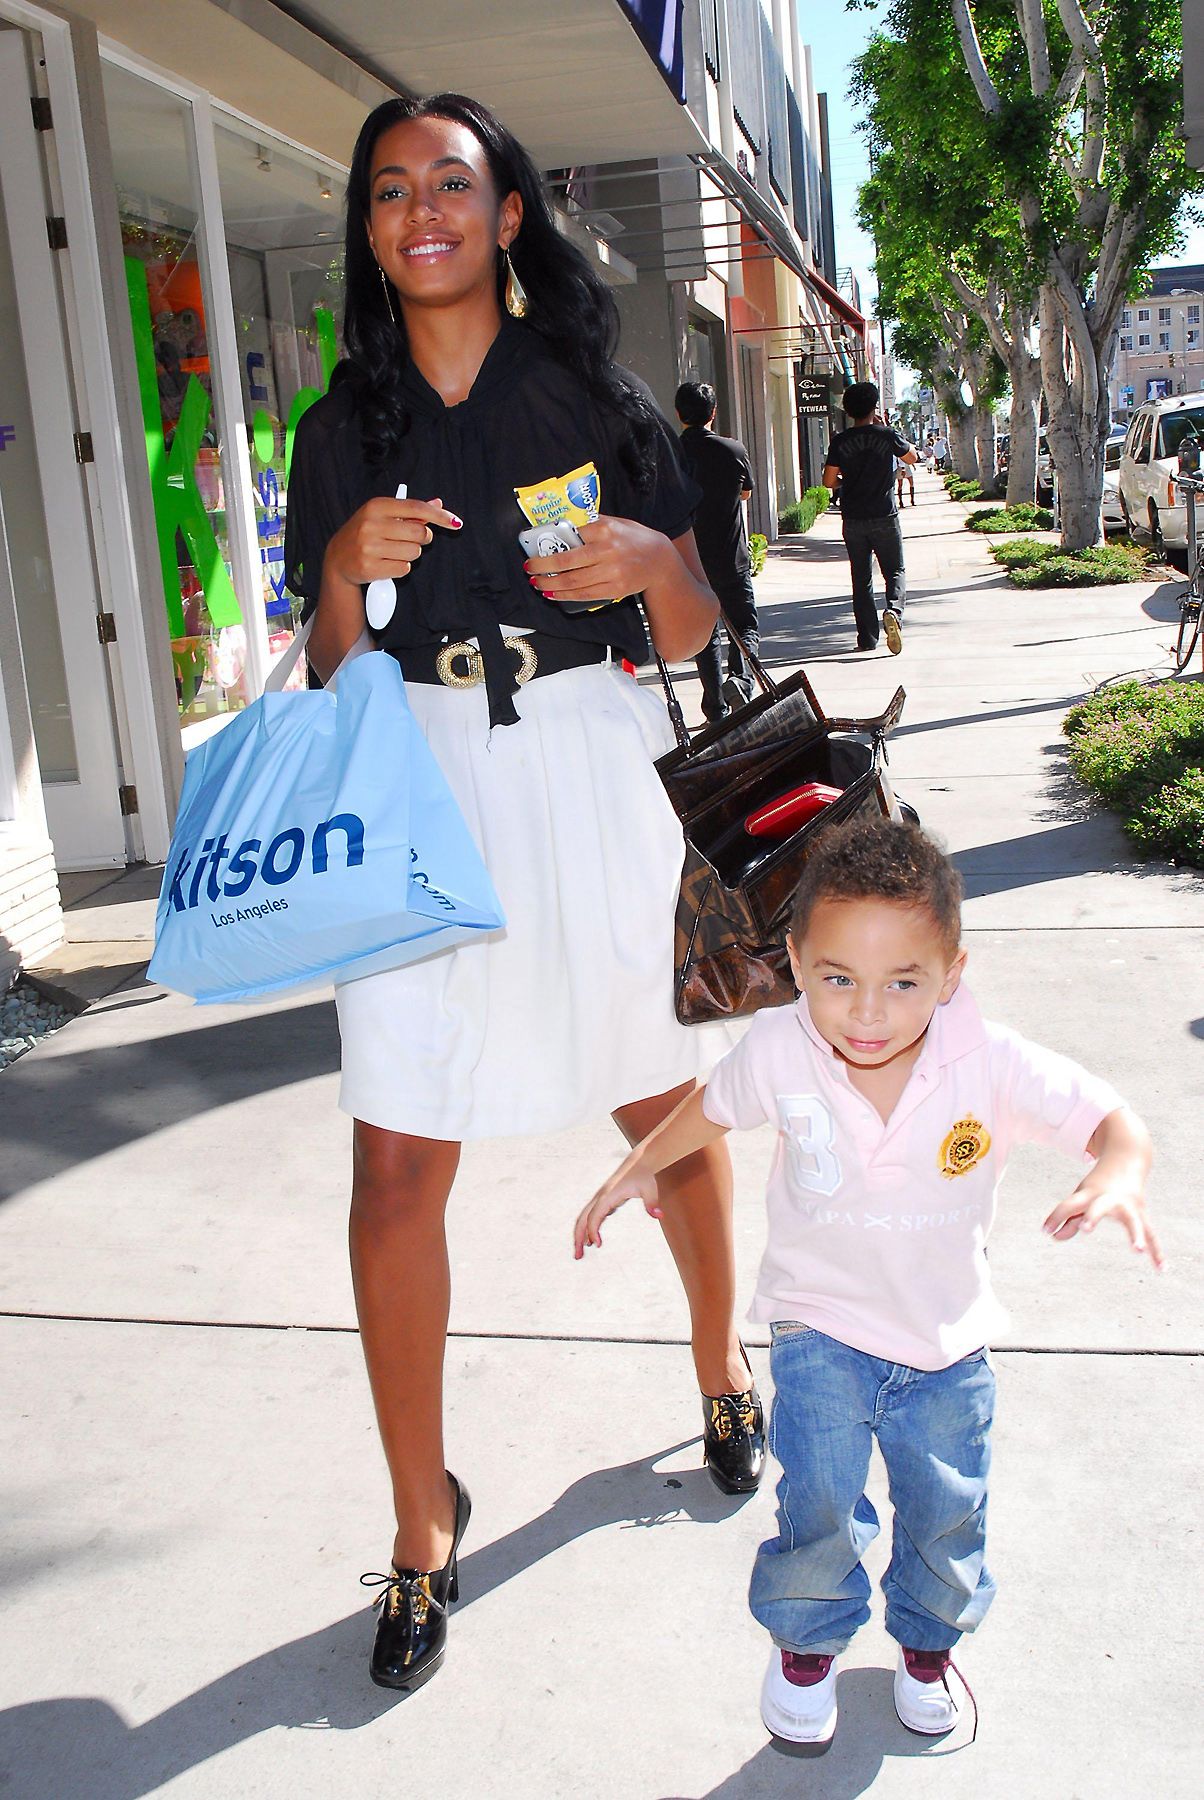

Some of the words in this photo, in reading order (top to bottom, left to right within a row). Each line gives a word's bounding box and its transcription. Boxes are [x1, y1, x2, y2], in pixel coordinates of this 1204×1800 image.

[798, 404, 828, 413] EYEWEAR
[167, 812, 365, 915] kitson
[211, 913, 235, 928] Los
[236, 898, 289, 922] Angeles
[776, 1093, 843, 1197] 3
